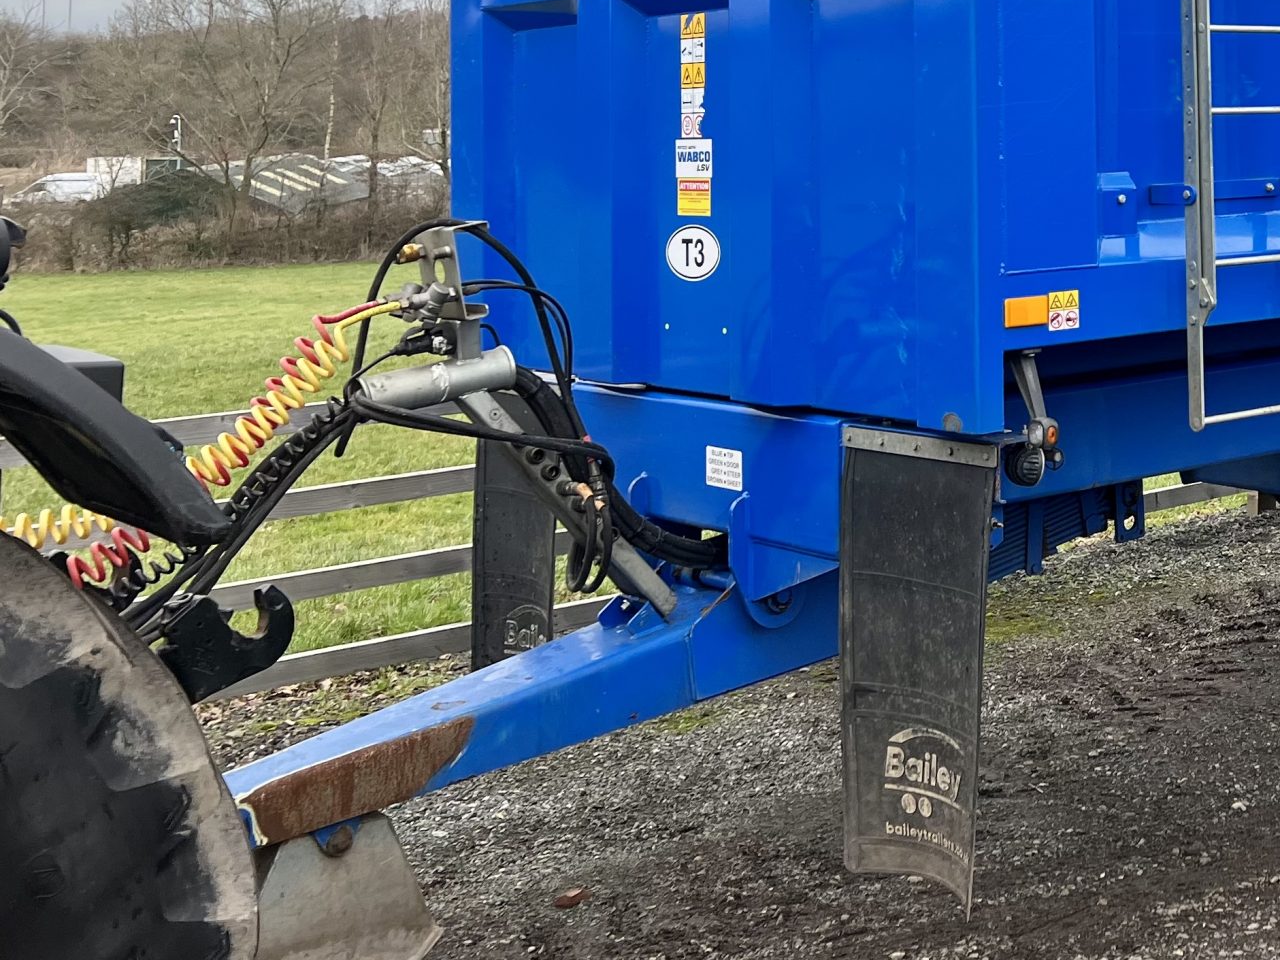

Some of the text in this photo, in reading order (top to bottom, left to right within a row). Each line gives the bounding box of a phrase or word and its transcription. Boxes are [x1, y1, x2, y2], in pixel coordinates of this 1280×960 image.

[677, 151, 711, 162] WABCO
[696, 164, 710, 172] LSV
[680, 182, 709, 190] ATTENTION
[681, 238, 705, 267] T3
[884, 745, 962, 804] Bailey
